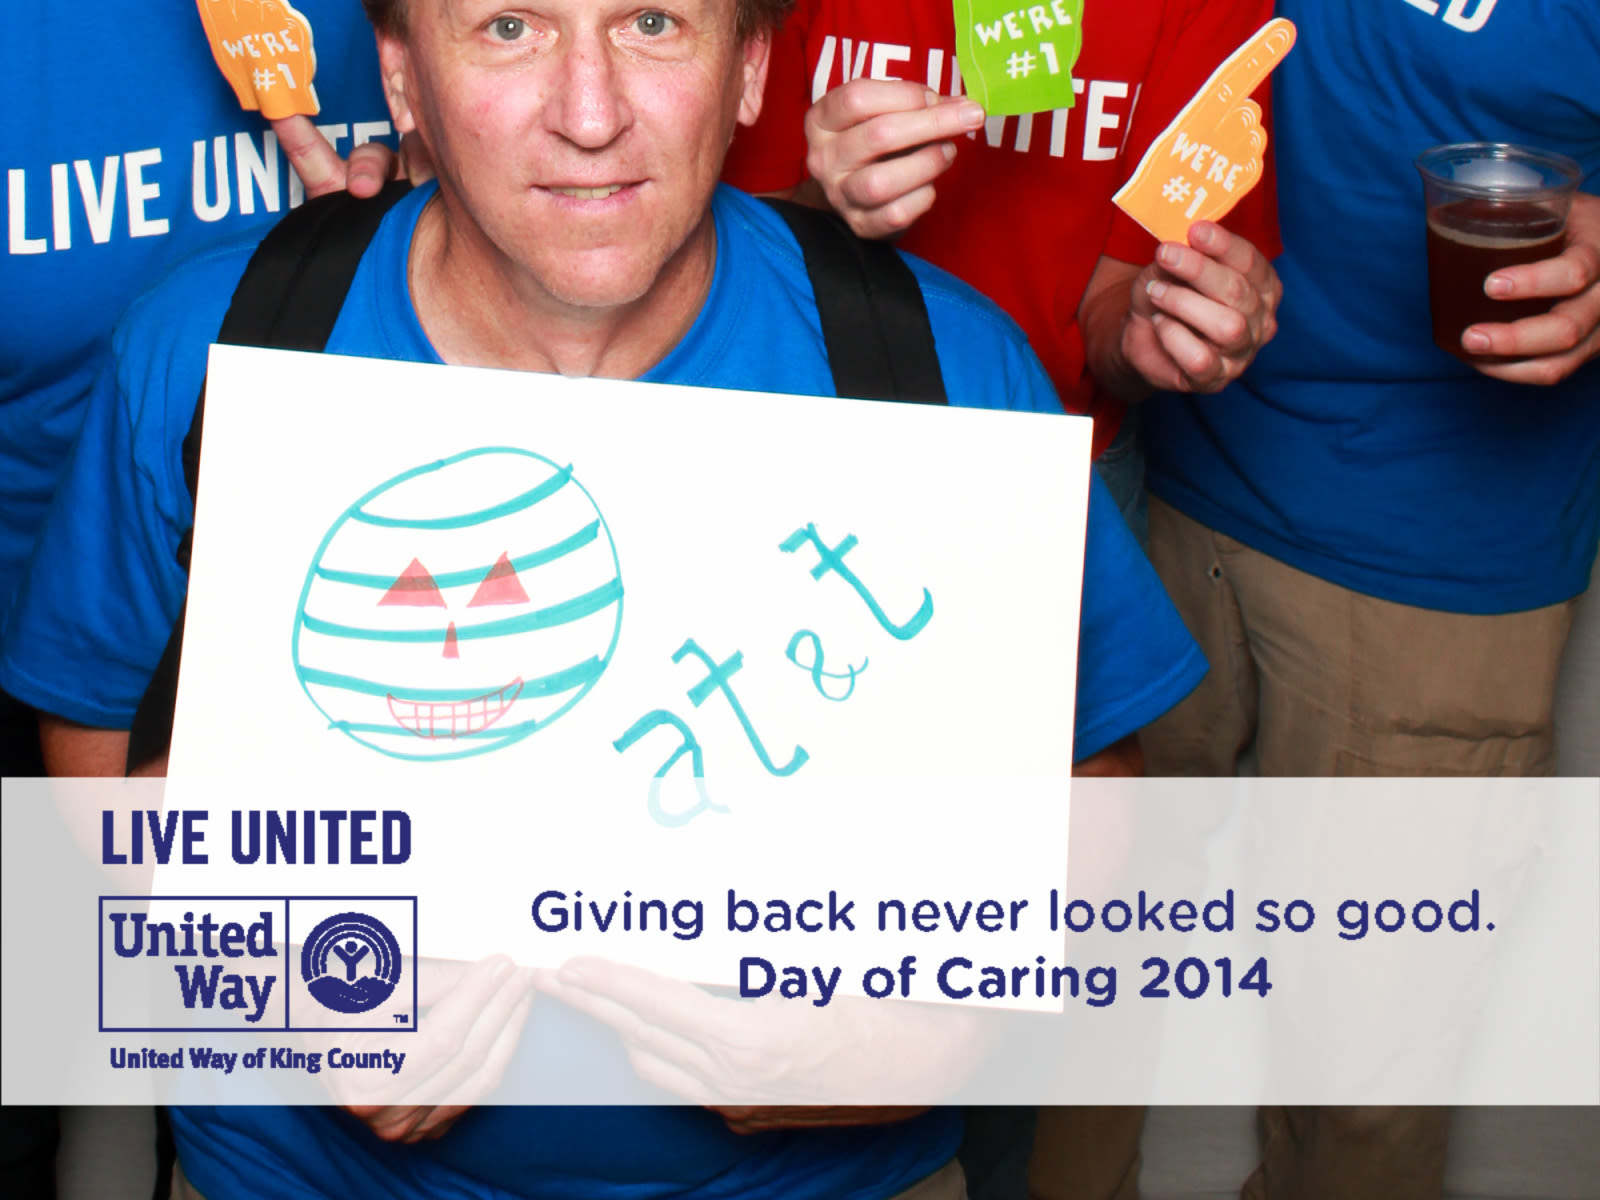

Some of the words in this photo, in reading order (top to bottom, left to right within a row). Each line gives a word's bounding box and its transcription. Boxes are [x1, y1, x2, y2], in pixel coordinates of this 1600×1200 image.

[222, 29, 300, 59] WE'RE
[1006, 42, 1060, 79] #1
[253, 63, 297, 92] #1
[1169, 131, 1243, 193] WE'RE
[8, 148, 169, 255] LIVE
[1161, 175, 1208, 219] #1
